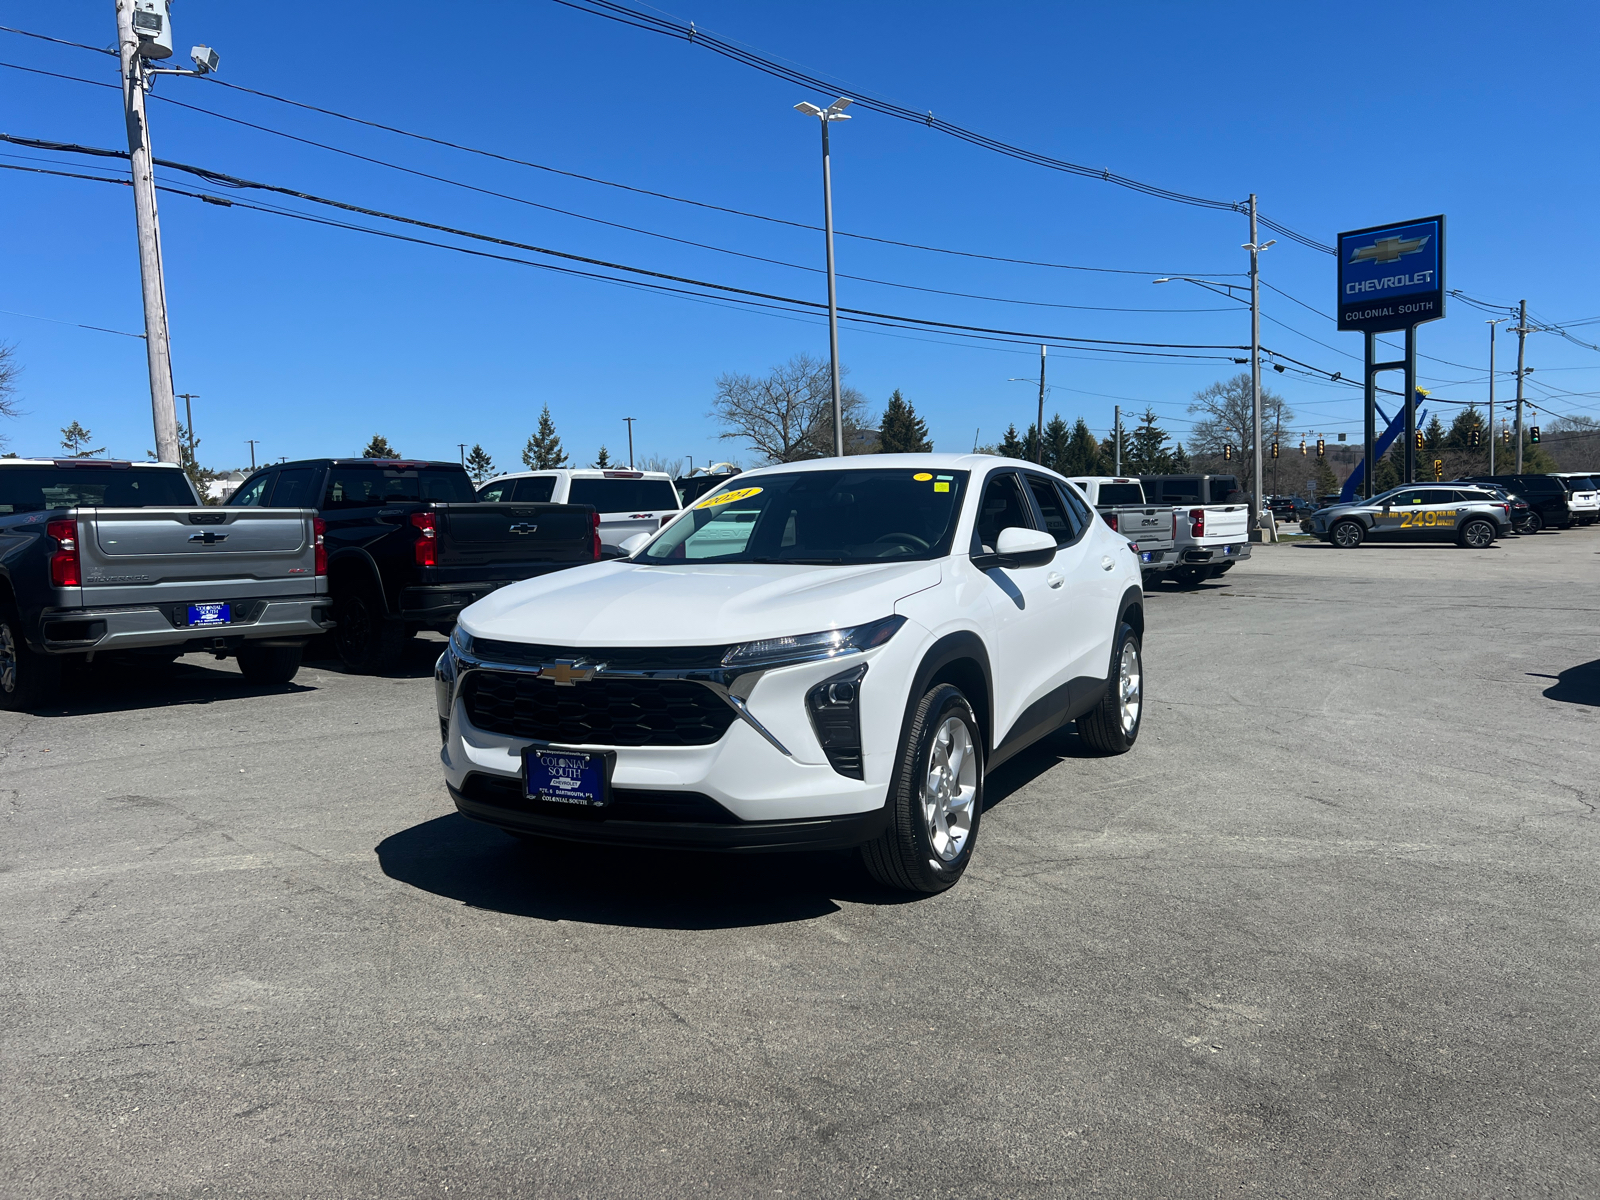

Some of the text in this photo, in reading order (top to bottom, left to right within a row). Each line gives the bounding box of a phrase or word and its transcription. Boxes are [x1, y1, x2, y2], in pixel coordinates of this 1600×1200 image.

[1346, 270, 1433, 294] CHEVROLET
[1345, 301, 1433, 321] COLONIAL SOUTH
[702, 488, 754, 507] 2024
[540, 756, 589, 769] COLONIAL
[548, 767, 581, 778] SOUTH
[541, 795, 569, 804] COLONIAL
[556, 789, 585, 797] DARTMOUTH,
